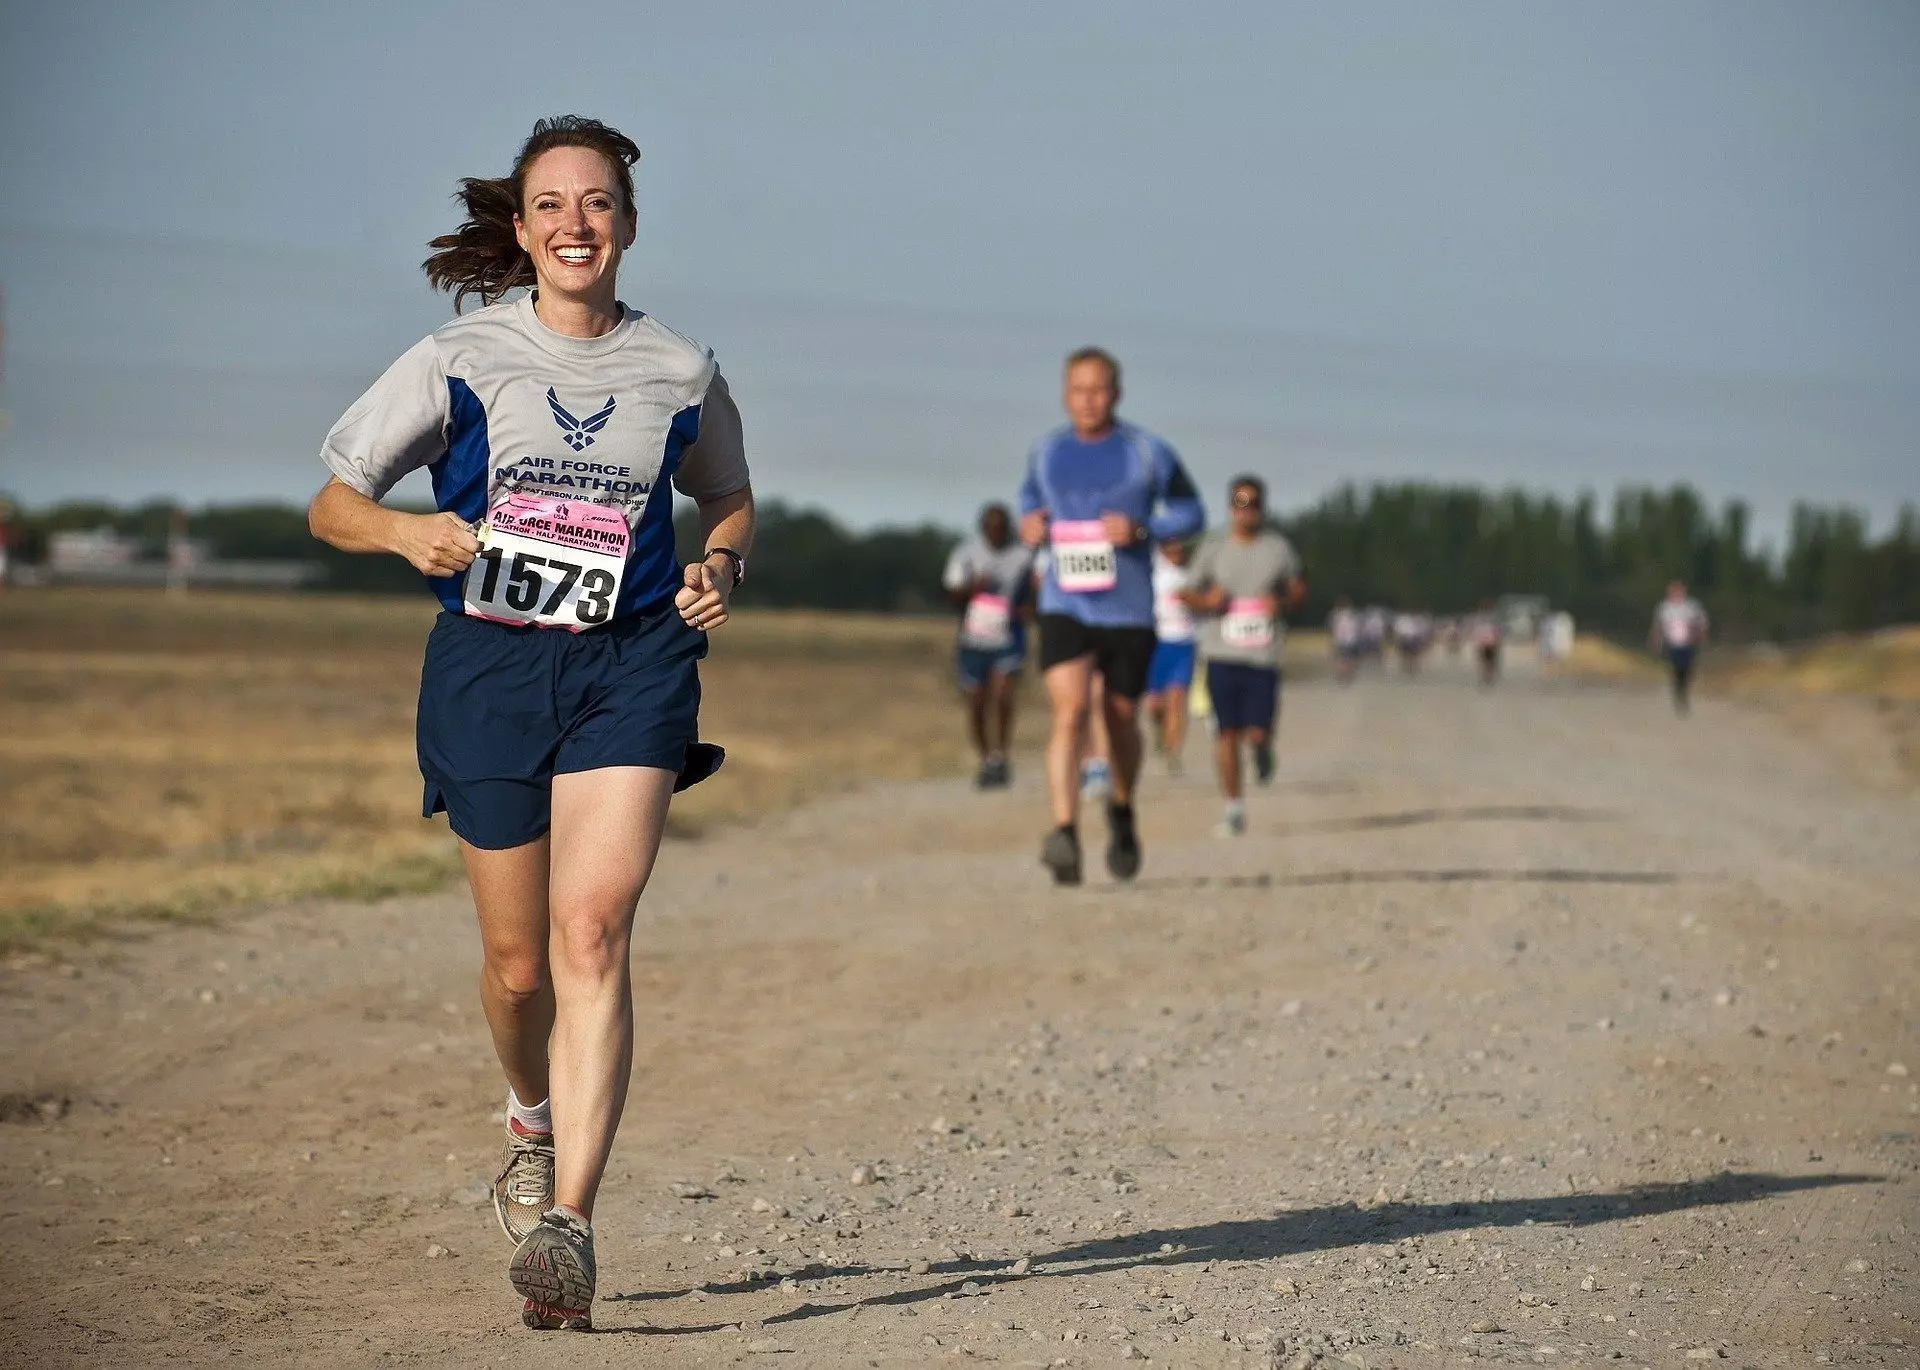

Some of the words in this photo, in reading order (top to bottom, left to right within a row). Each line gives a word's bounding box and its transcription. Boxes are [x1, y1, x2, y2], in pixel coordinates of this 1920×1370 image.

[518, 456, 554, 469] AIR
[561, 460, 631, 477] FORCE
[495, 467, 650, 494] MARATHON
[593, 497, 624, 506] DAYTON,
[493, 510, 515, 525] AIR
[518, 516, 552, 531] ORCE
[555, 522, 626, 546] MARATHON
[536, 530, 557, 539] HALF
[557, 534, 600, 549] MARATHON
[606, 545, 621, 553] 10K
[477, 546, 616, 624] 1573
